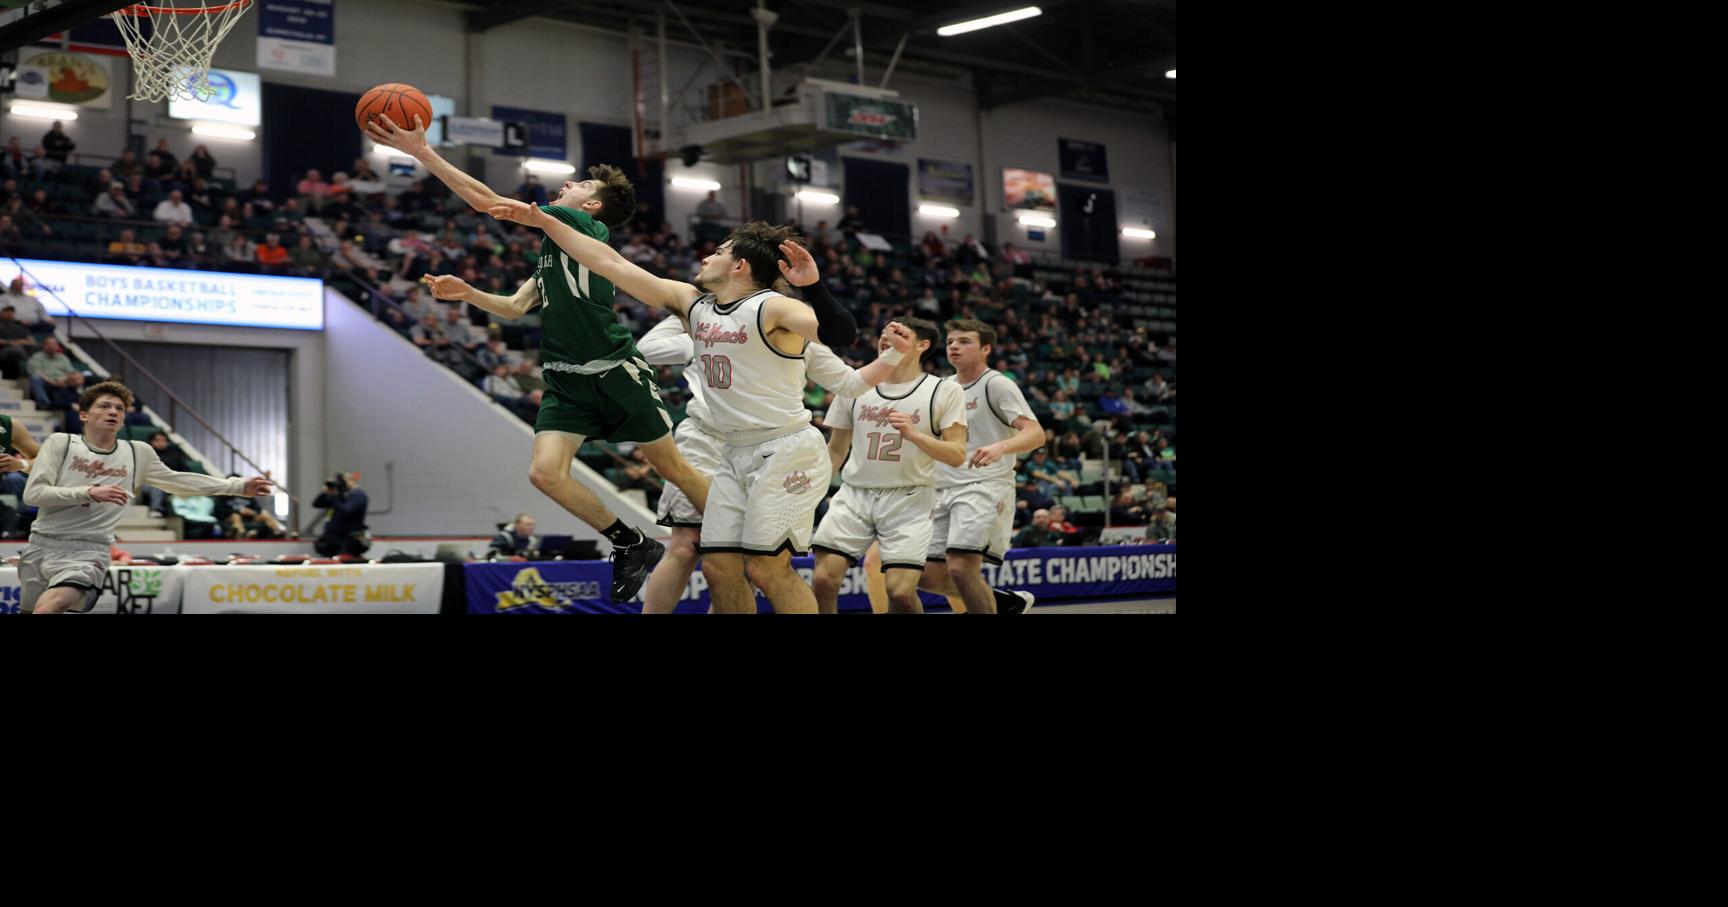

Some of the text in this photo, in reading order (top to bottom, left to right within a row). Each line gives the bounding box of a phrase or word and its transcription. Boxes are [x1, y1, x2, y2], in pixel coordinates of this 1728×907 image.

[85, 275, 237, 296] BOYS BASKETBALL
[85, 291, 237, 313] CHAMPIONSHIPS
[700, 354, 732, 389] 10
[867, 431, 902, 462] 12
[981, 558, 1042, 587] TATE
[209, 583, 416, 604] CHOCOLATE MILK
